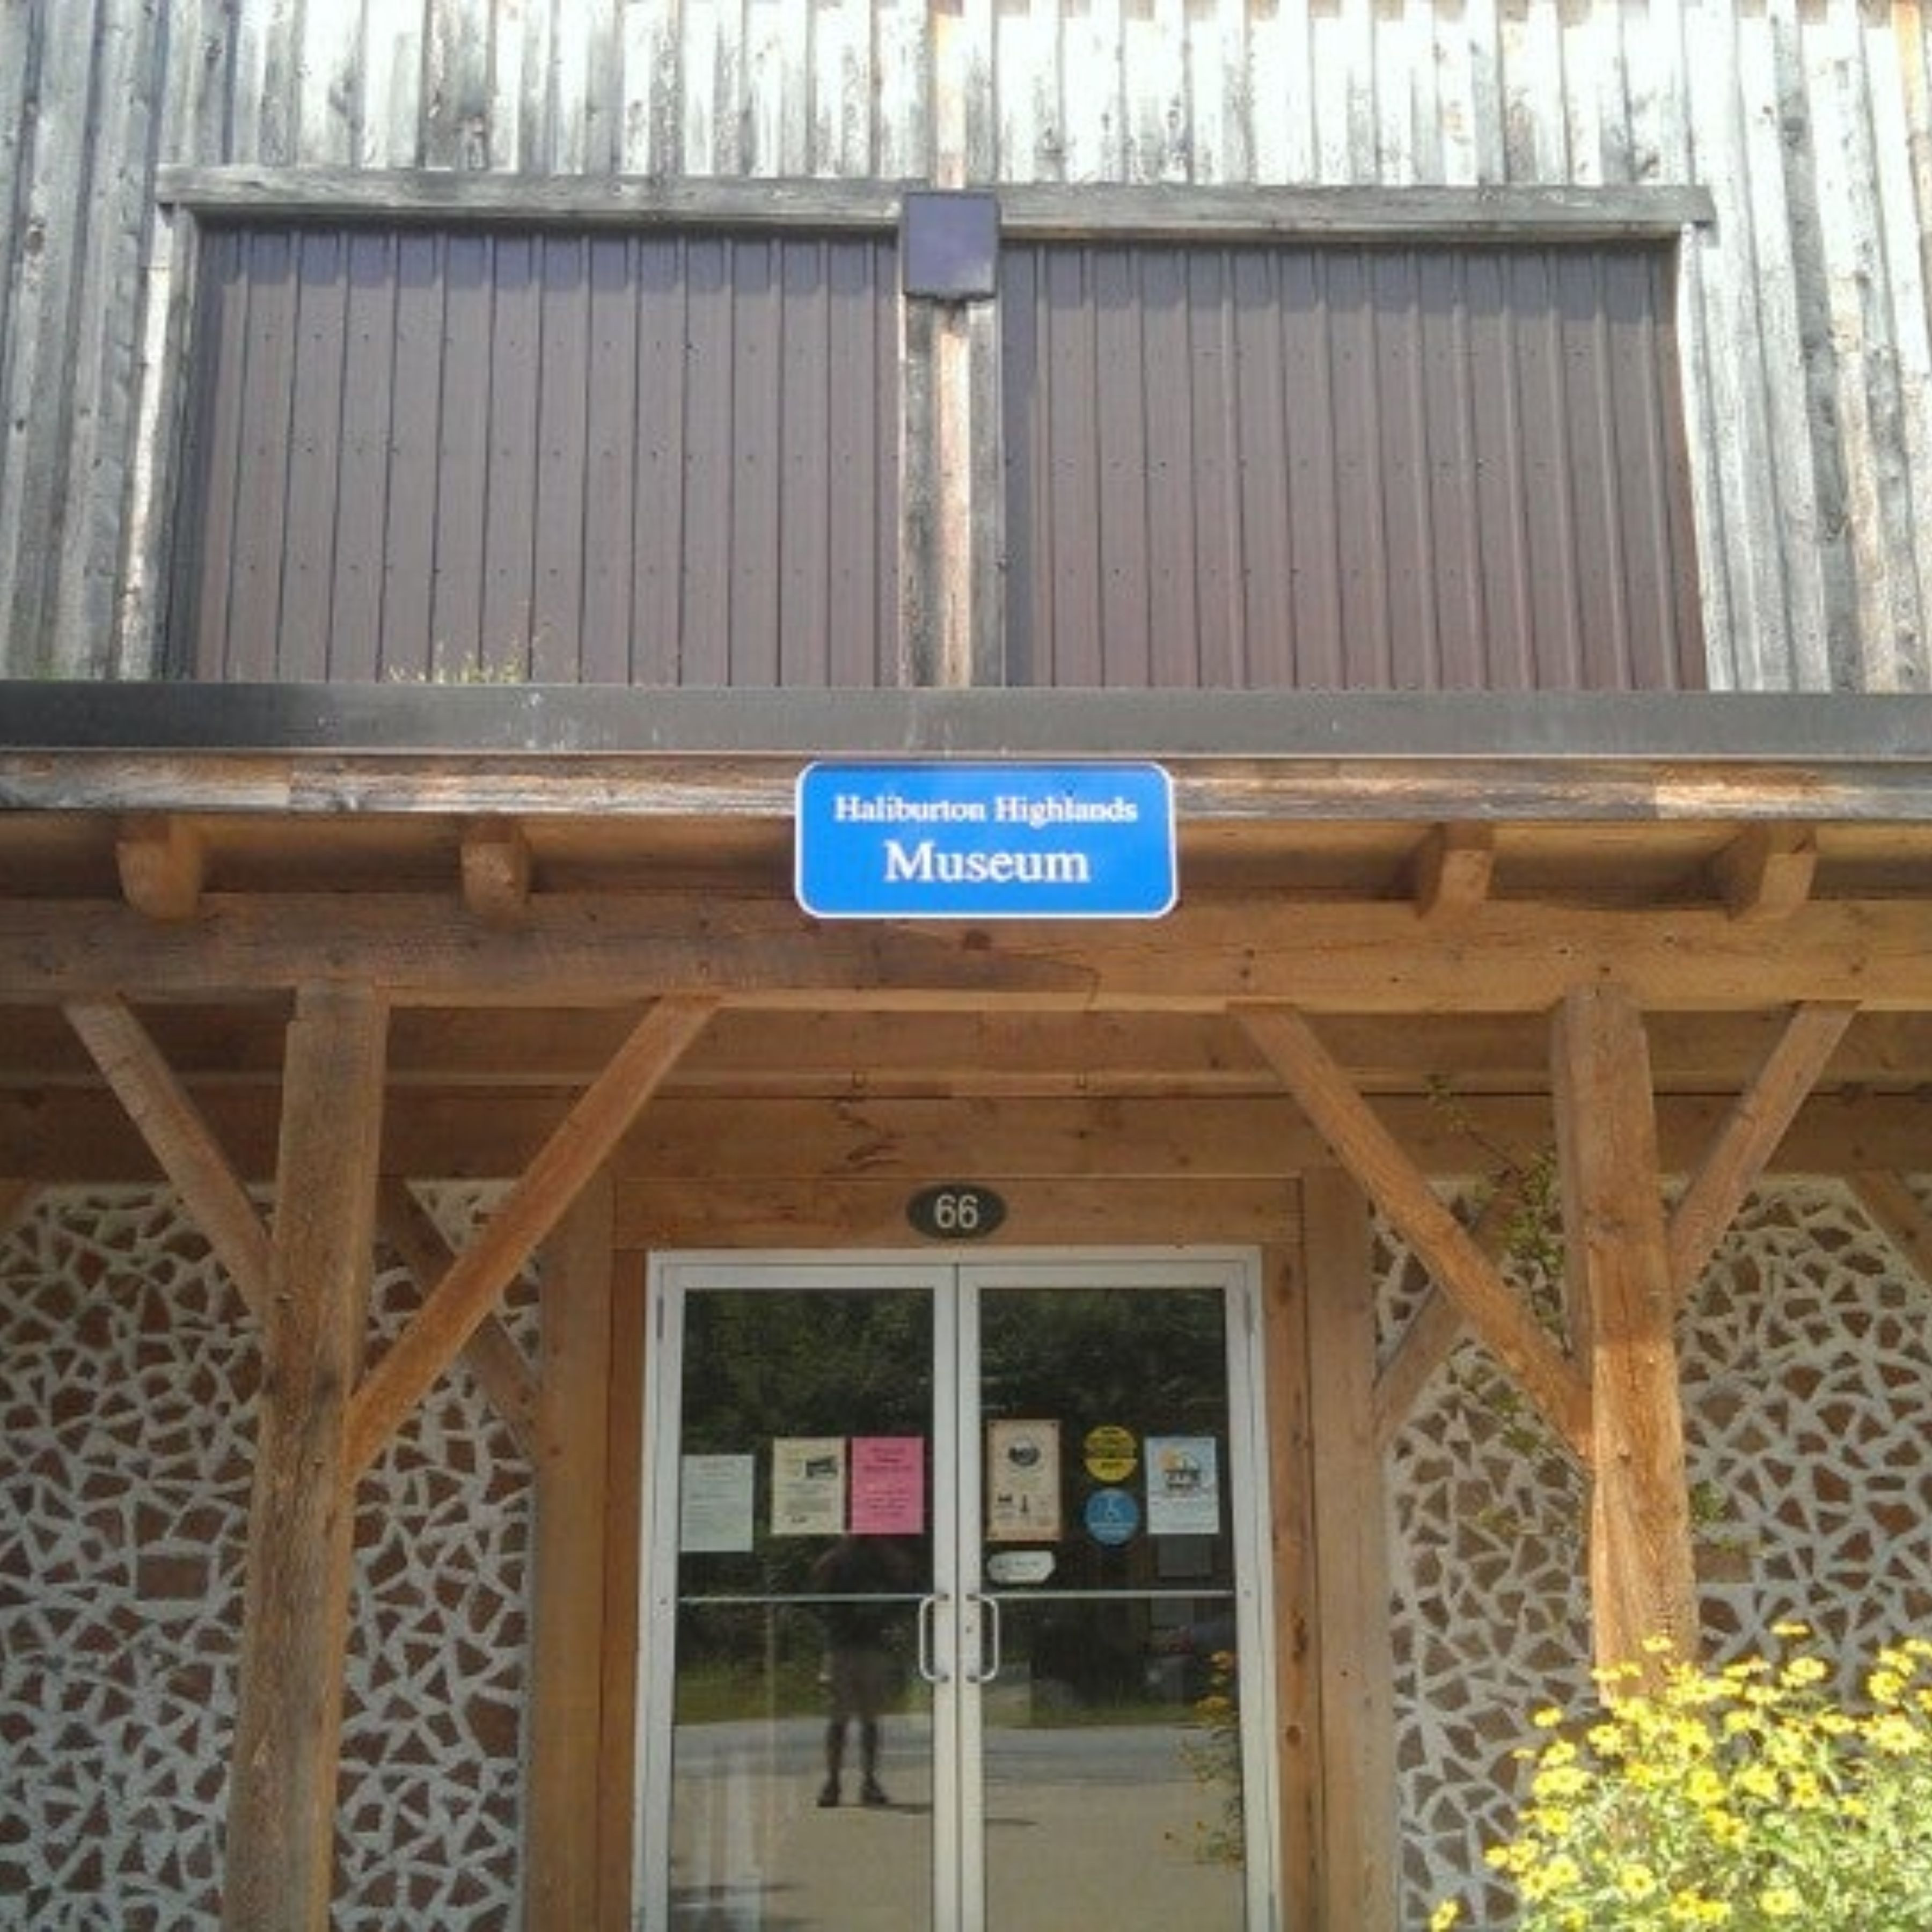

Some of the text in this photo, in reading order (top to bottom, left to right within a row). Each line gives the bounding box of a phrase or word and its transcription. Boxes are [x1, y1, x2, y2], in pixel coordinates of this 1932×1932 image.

[834, 794, 1139, 829] Haliburton Highlands
[883, 839, 1091, 883] Museum
[935, 1194, 978, 1229] 66
